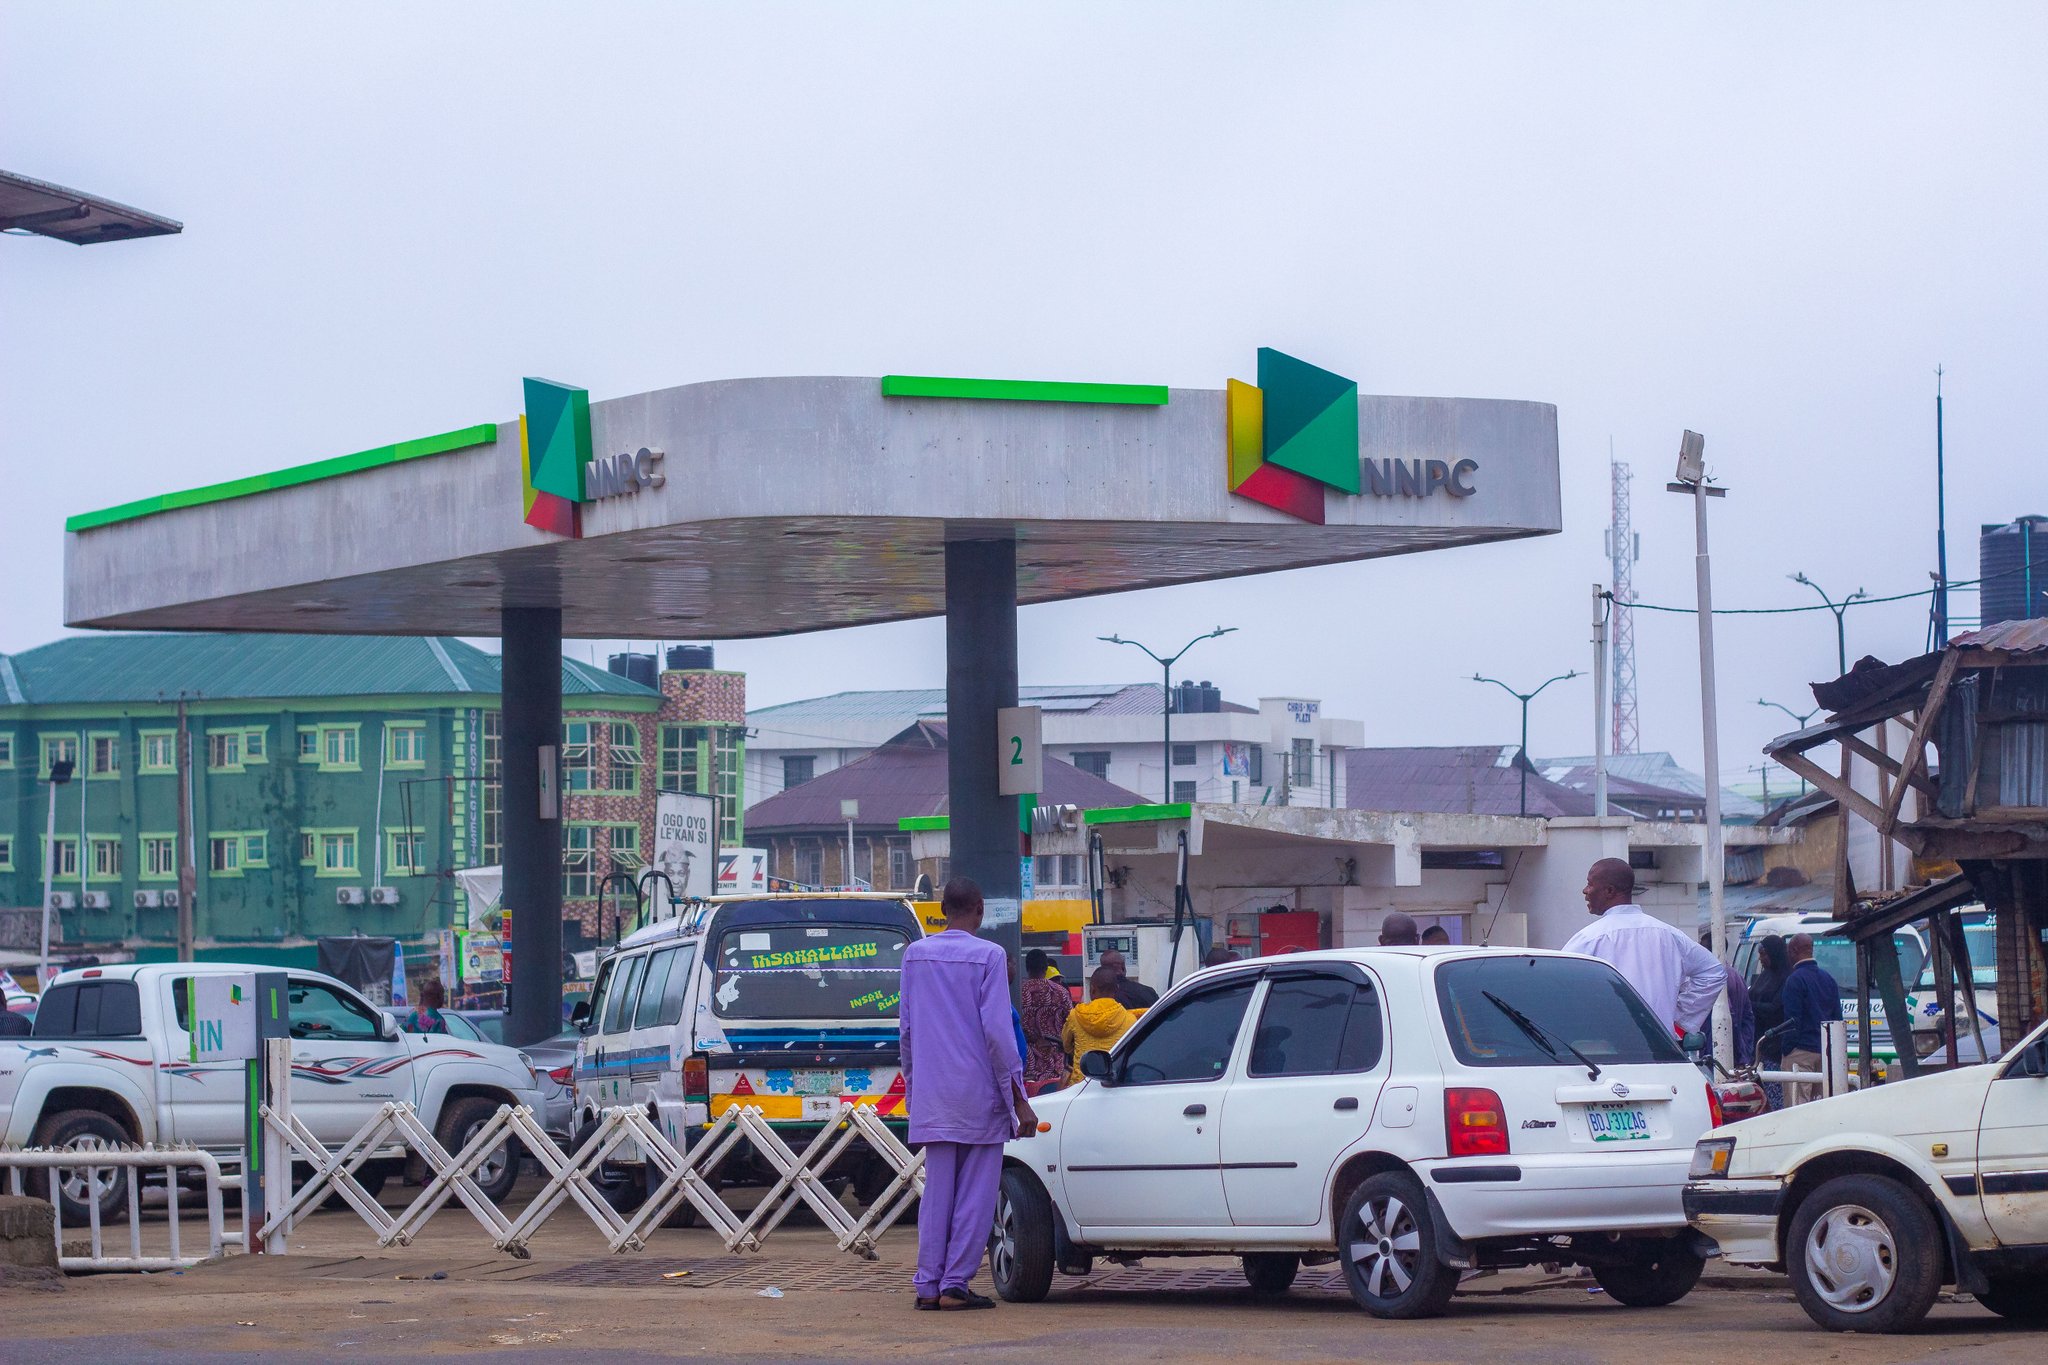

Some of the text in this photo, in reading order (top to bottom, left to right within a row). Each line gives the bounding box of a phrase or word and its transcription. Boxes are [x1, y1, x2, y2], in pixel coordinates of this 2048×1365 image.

[585, 447, 665, 500] NNPC
[1359, 457, 1479, 498] NNPC
[1010, 735, 1023, 765] 2
[663, 813, 706, 830] OGO OYO
[1031, 803, 1078, 833] NNPC
[660, 827, 707, 844] LE'KAN SI
[850, 990, 883, 1008] INSAH
[200, 1019, 222, 1052] IN
